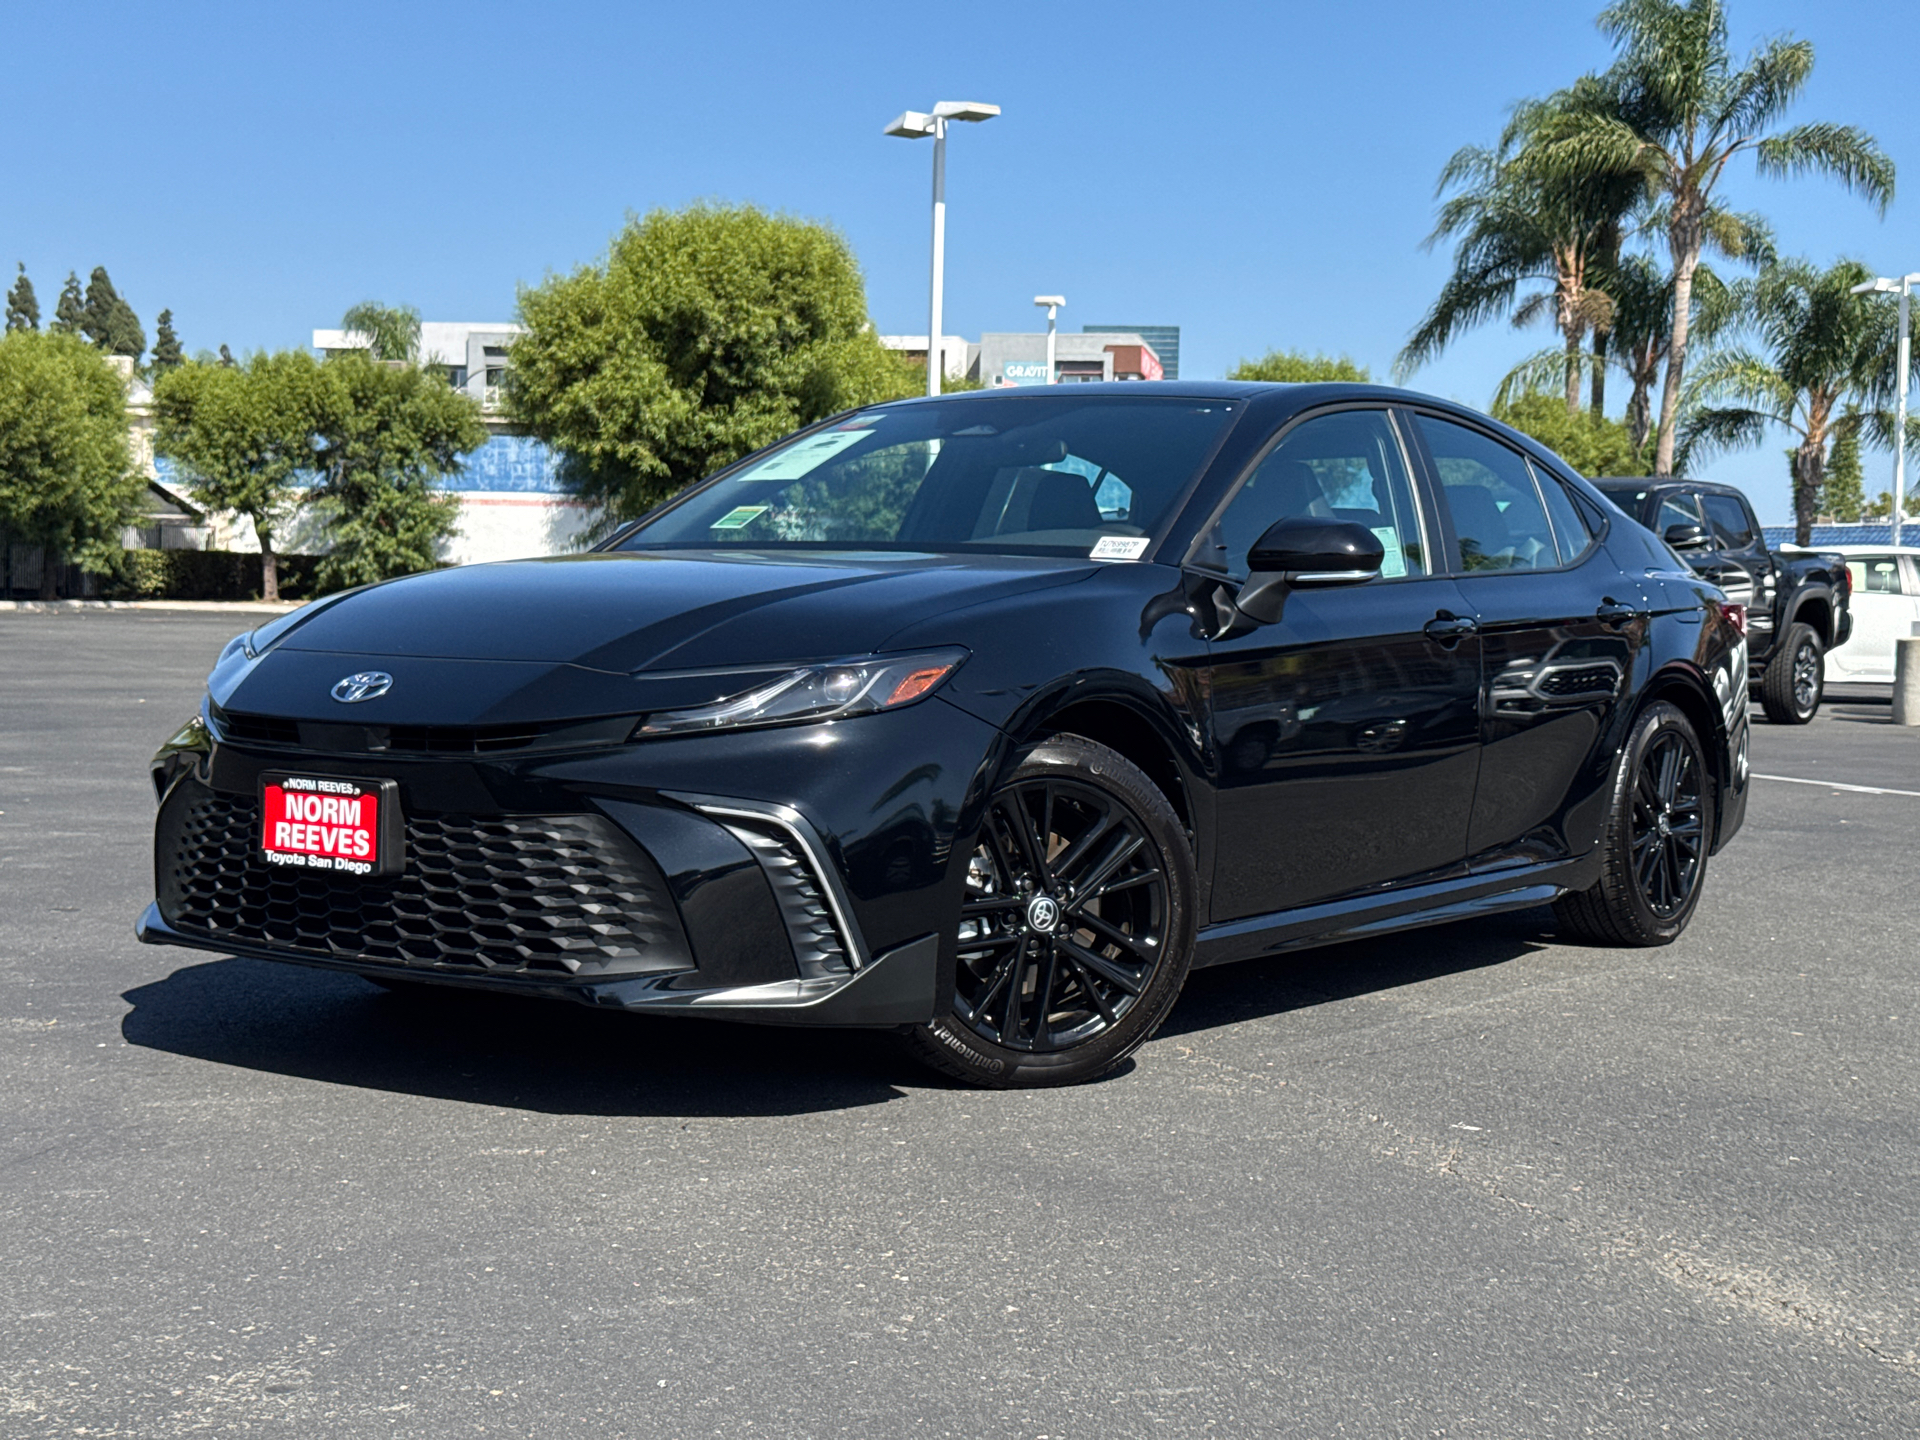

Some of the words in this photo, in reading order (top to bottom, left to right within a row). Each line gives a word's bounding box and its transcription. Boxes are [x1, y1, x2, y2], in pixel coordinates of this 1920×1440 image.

[1006, 365, 1048, 378] GRAVIT
[288, 778, 317, 791] NORM
[318, 780, 353, 795] REEVES
[285, 794, 361, 827] NORM
[275, 822, 370, 857] REEVES
[264, 850, 306, 867] Toyota
[307, 853, 332, 869] San
[334, 858, 372, 875] Diego
